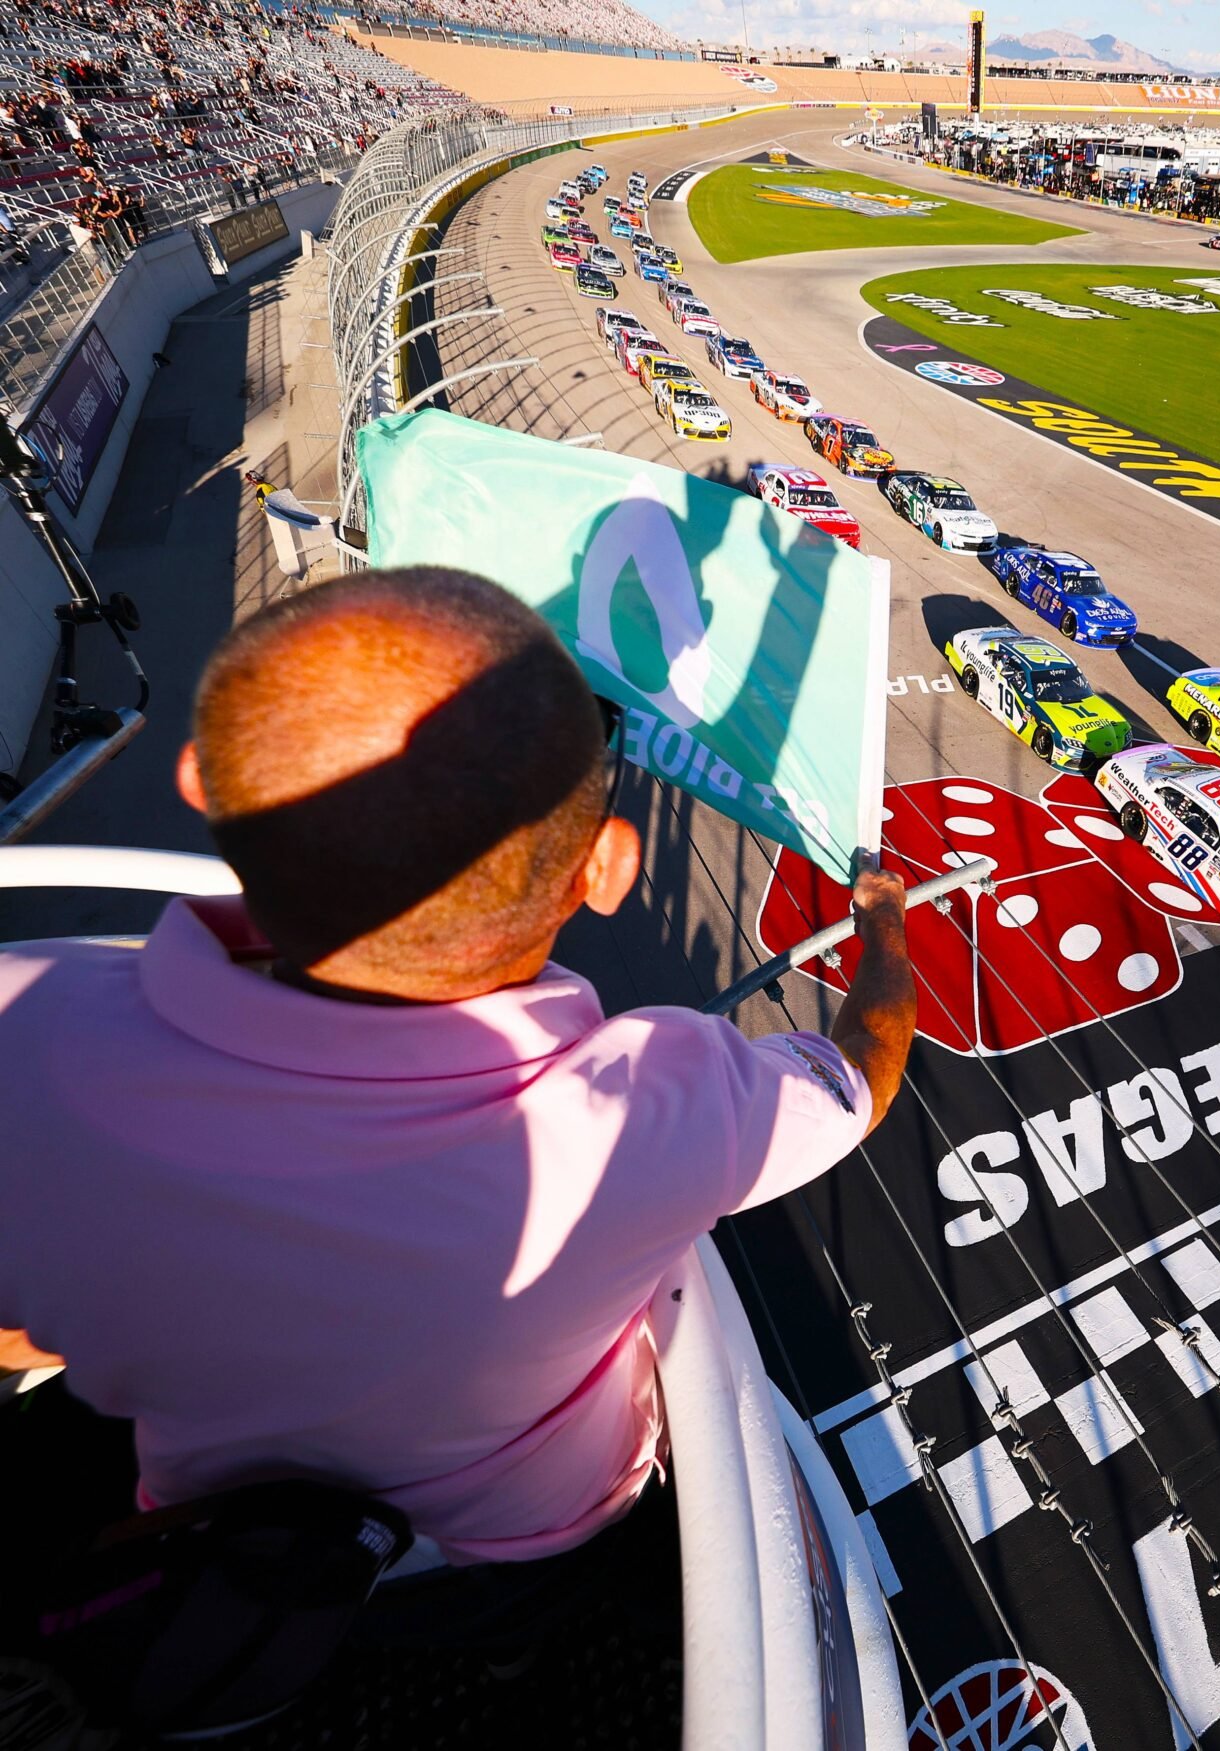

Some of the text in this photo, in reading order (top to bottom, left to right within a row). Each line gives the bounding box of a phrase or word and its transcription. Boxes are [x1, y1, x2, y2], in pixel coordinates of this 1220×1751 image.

[827, 439, 834, 454] 1
[792, 509, 857, 522] WHELEN
[912, 498, 924, 524] 16
[966, 650, 996, 683] younglife
[998, 682, 1015, 722] 19
[1069, 718, 1119, 735] younglife
[1110, 762, 1177, 832] WeatherTech
[1167, 833, 1210, 872] 88
